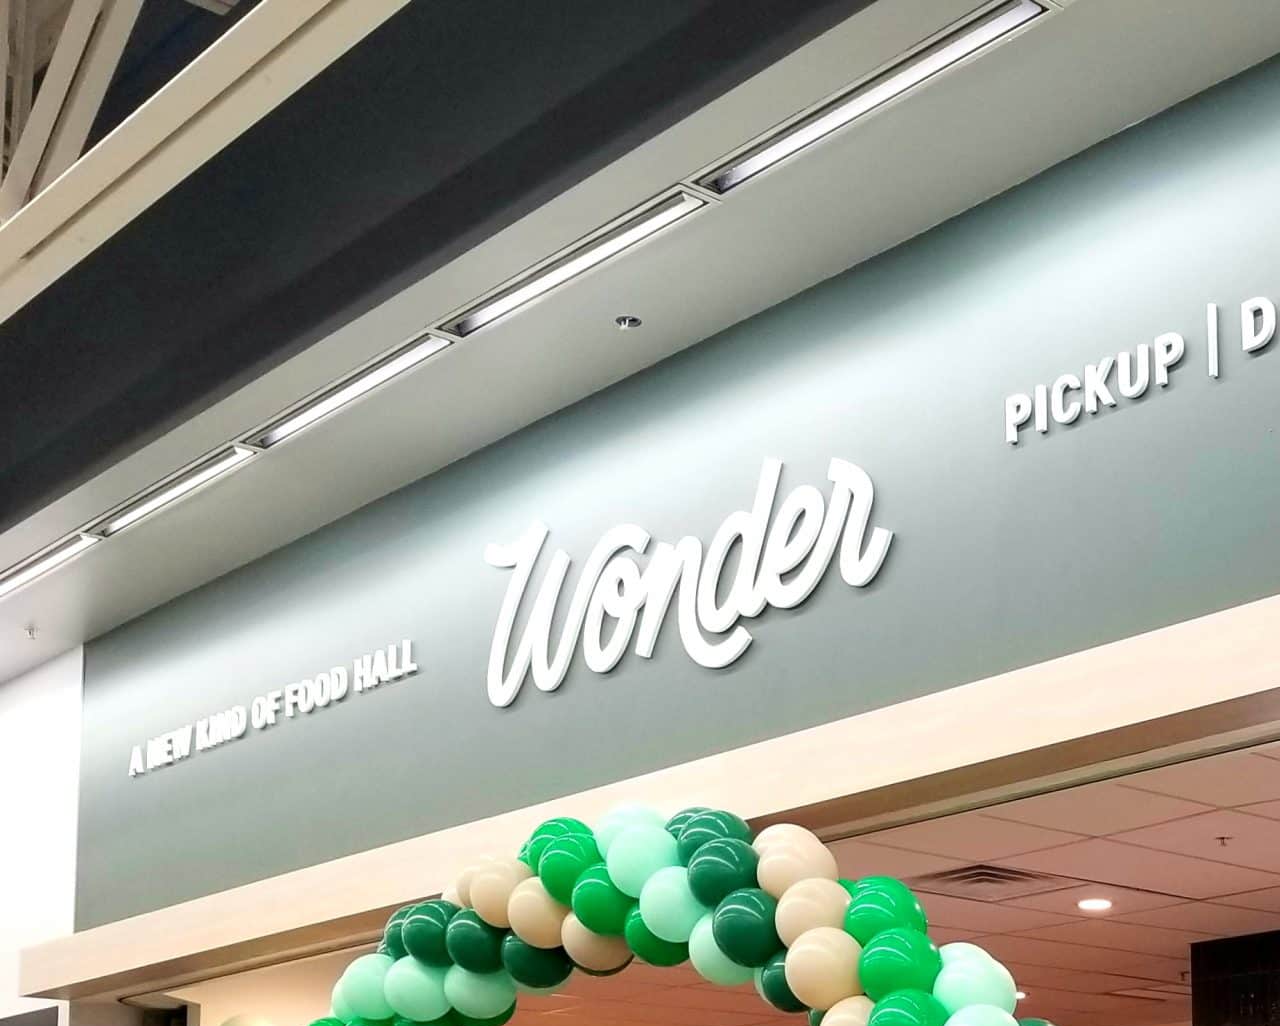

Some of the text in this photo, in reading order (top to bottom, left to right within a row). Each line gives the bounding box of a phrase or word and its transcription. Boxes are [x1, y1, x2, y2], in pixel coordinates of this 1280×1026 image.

[1005, 332, 1186, 446] PICKUP
[484, 455, 895, 709] Wonder
[128, 639, 418, 777] A NEW KIND OF FOOD HALL
